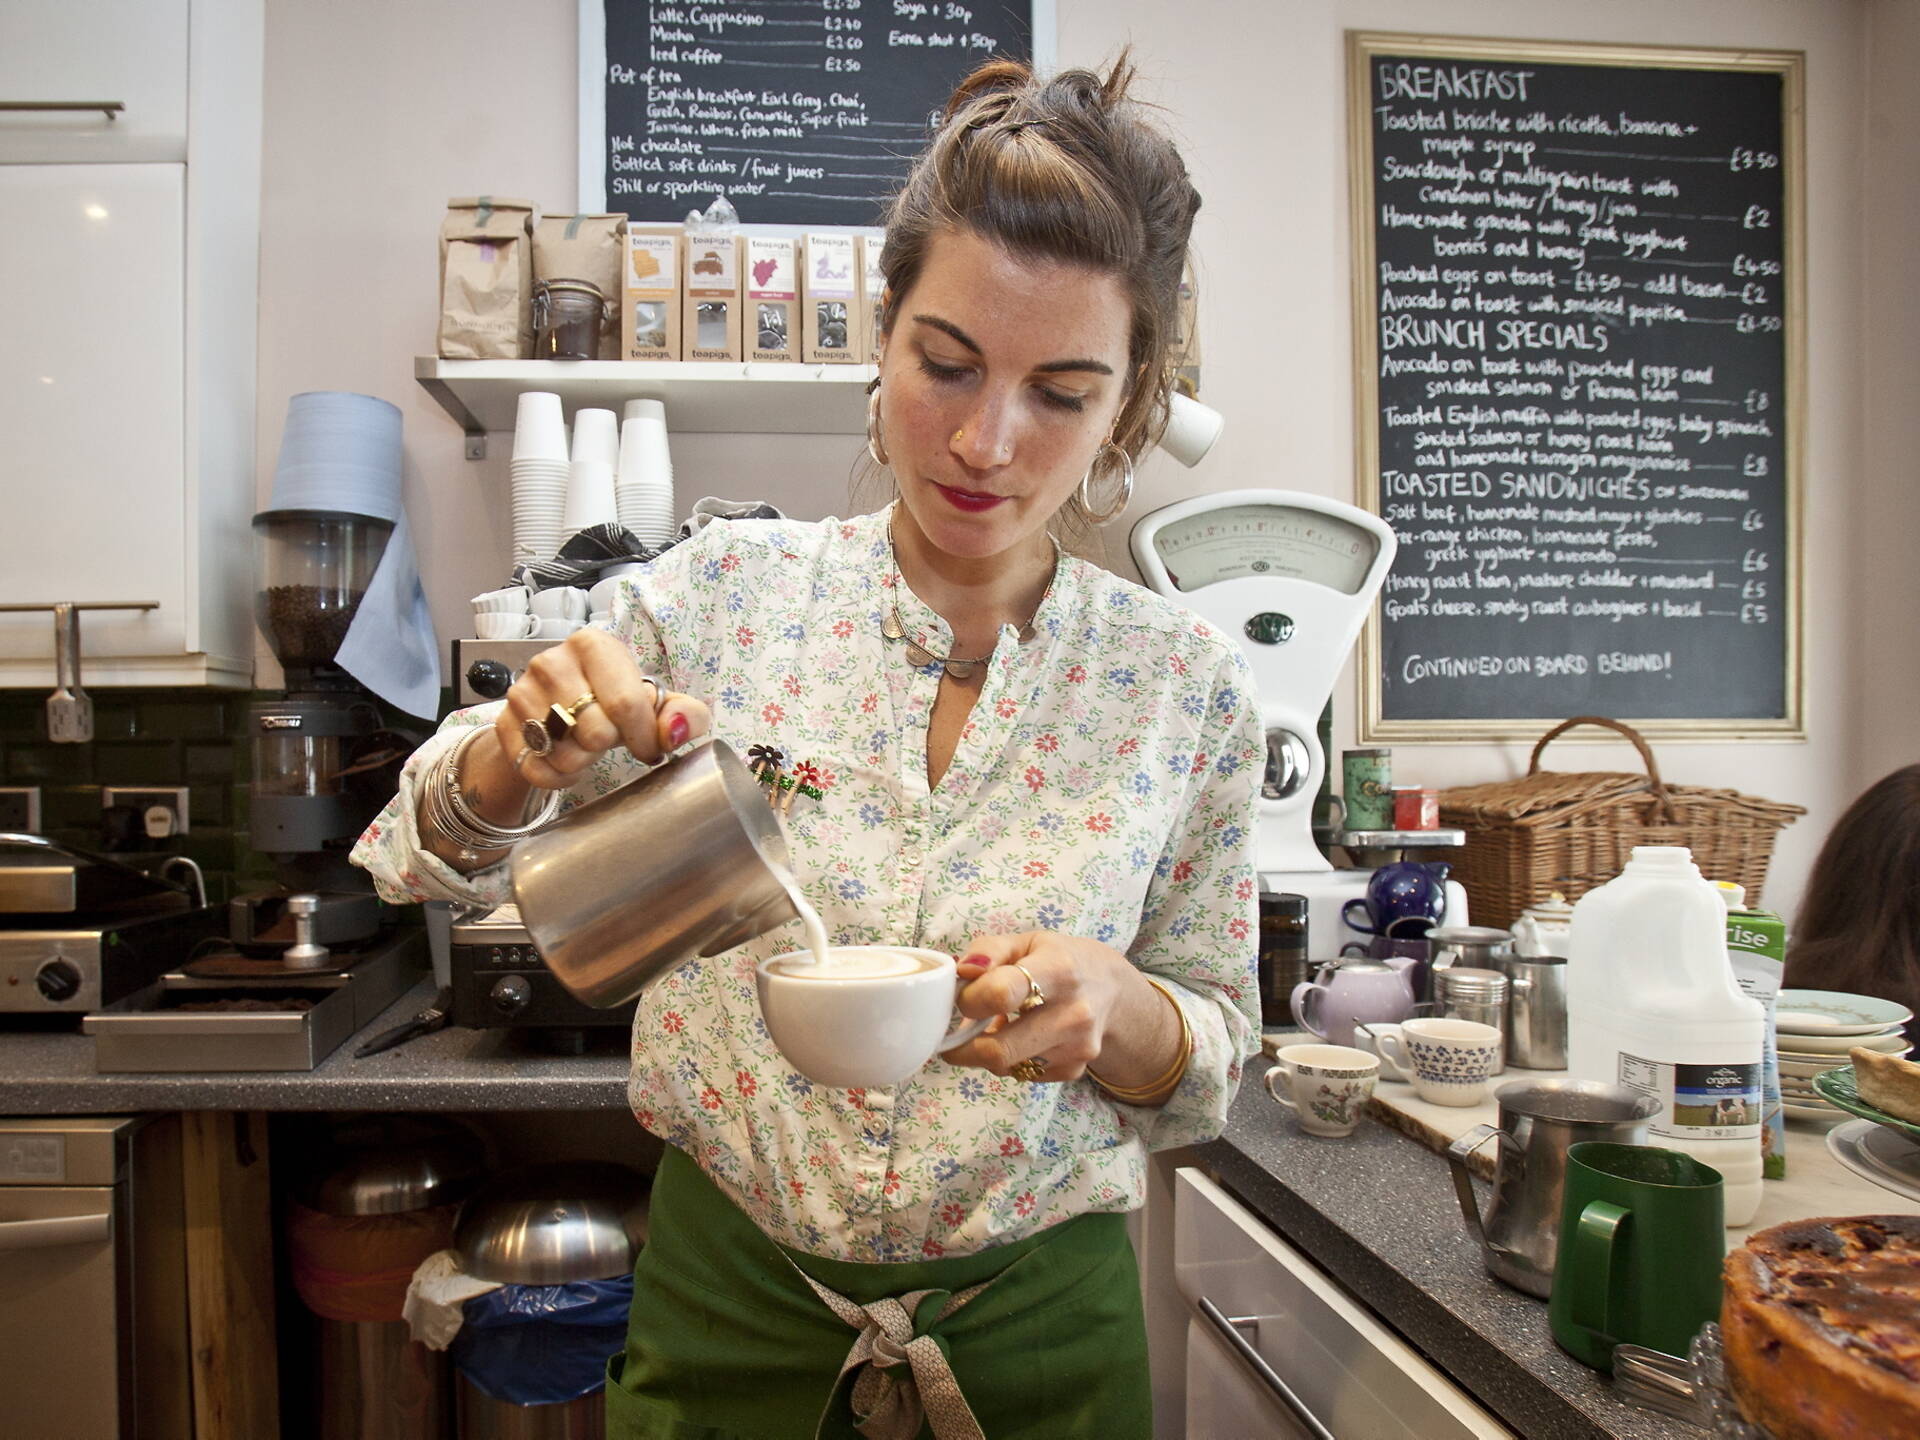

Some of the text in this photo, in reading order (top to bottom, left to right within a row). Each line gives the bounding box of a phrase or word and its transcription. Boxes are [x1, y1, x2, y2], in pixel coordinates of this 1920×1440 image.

[893, 0, 973, 25] Soya 30p
[650, 25, 695, 43] Mocha
[888, 30, 924, 47] Extra
[928, 32, 954, 47] shot
[650, 45, 678, 62] Iced
[681, 48, 722, 65] coffee
[610, 64, 682, 85] Pot of tea
[1379, 63, 1536, 102] BREAKFAST
[647, 86, 695, 107] English
[762, 91, 789, 106] Earl
[741, 123, 770, 139] fresh
[773, 125, 803, 138] mint
[836, 111, 869, 129] fruit
[1375, 105, 1447, 132] Toasted
[1516, 111, 1555, 133] with
[611, 135, 703, 155] Hot chocolate
[1422, 135, 1475, 160] maple
[1483, 139, 1536, 169] syrup
[612, 154, 664, 172] Bottled
[669, 157, 694, 174] soft
[698, 158, 737, 173] drinks
[785, 162, 825, 183] juices
[613, 177, 766, 200] Still or sparkling water
[1478, 167, 1498, 184] or
[1641, 177, 1679, 197] with
[1537, 218, 1572, 236] with
[1743, 204, 1771, 229] £2
[1493, 237, 1529, 257] and
[1537, 240, 1585, 271] honey
[1381, 260, 1438, 285] Poached
[1441, 269, 1479, 294] eggs
[1484, 271, 1507, 285] on
[1509, 265, 1556, 288] toast
[1643, 273, 1677, 295] add
[1681, 275, 1726, 299] bacon
[1381, 288, 1446, 312] Avocado
[1451, 299, 1471, 313] on
[1475, 292, 1522, 315] toast
[1527, 294, 1560, 313] with
[1381, 314, 1609, 352] BRUNCH SPECIALS
[1381, 351, 1714, 389] Avocado on toast with poached eggs and
[1426, 378, 1490, 399] smoked
[1493, 378, 1552, 396] salmon
[1561, 385, 1581, 400] or
[1383, 405, 1443, 427] Toasted
[1447, 405, 1500, 433] English
[1502, 406, 1551, 426] muffin
[1553, 409, 1585, 425] with
[1679, 412, 1713, 444] baby
[1468, 428, 1523, 447] salmon
[1525, 432, 1542, 445] or
[1547, 428, 1592, 453] honey
[1595, 433, 1634, 450] roast
[1415, 449, 1446, 467] and
[1450, 448, 1529, 468] homemade
[1382, 470, 1492, 499] TOASTED
[1500, 471, 1650, 501] SANDWICHES
[1385, 503, 1417, 522] Salt
[1466, 501, 1540, 521] homemade
[1424, 545, 1470, 572] greek
[1474, 545, 1536, 572] yoghurt
[1385, 573, 1431, 602] Honey
[1432, 571, 1471, 590] roast
[1484, 599, 1529, 623] smoky
[1531, 596, 1569, 616] roast
[1663, 598, 1703, 618] basil
[1403, 652, 1672, 684] CONTINUED ON BOARD BEHIND!
[1706, 1075, 1743, 1088] organic
